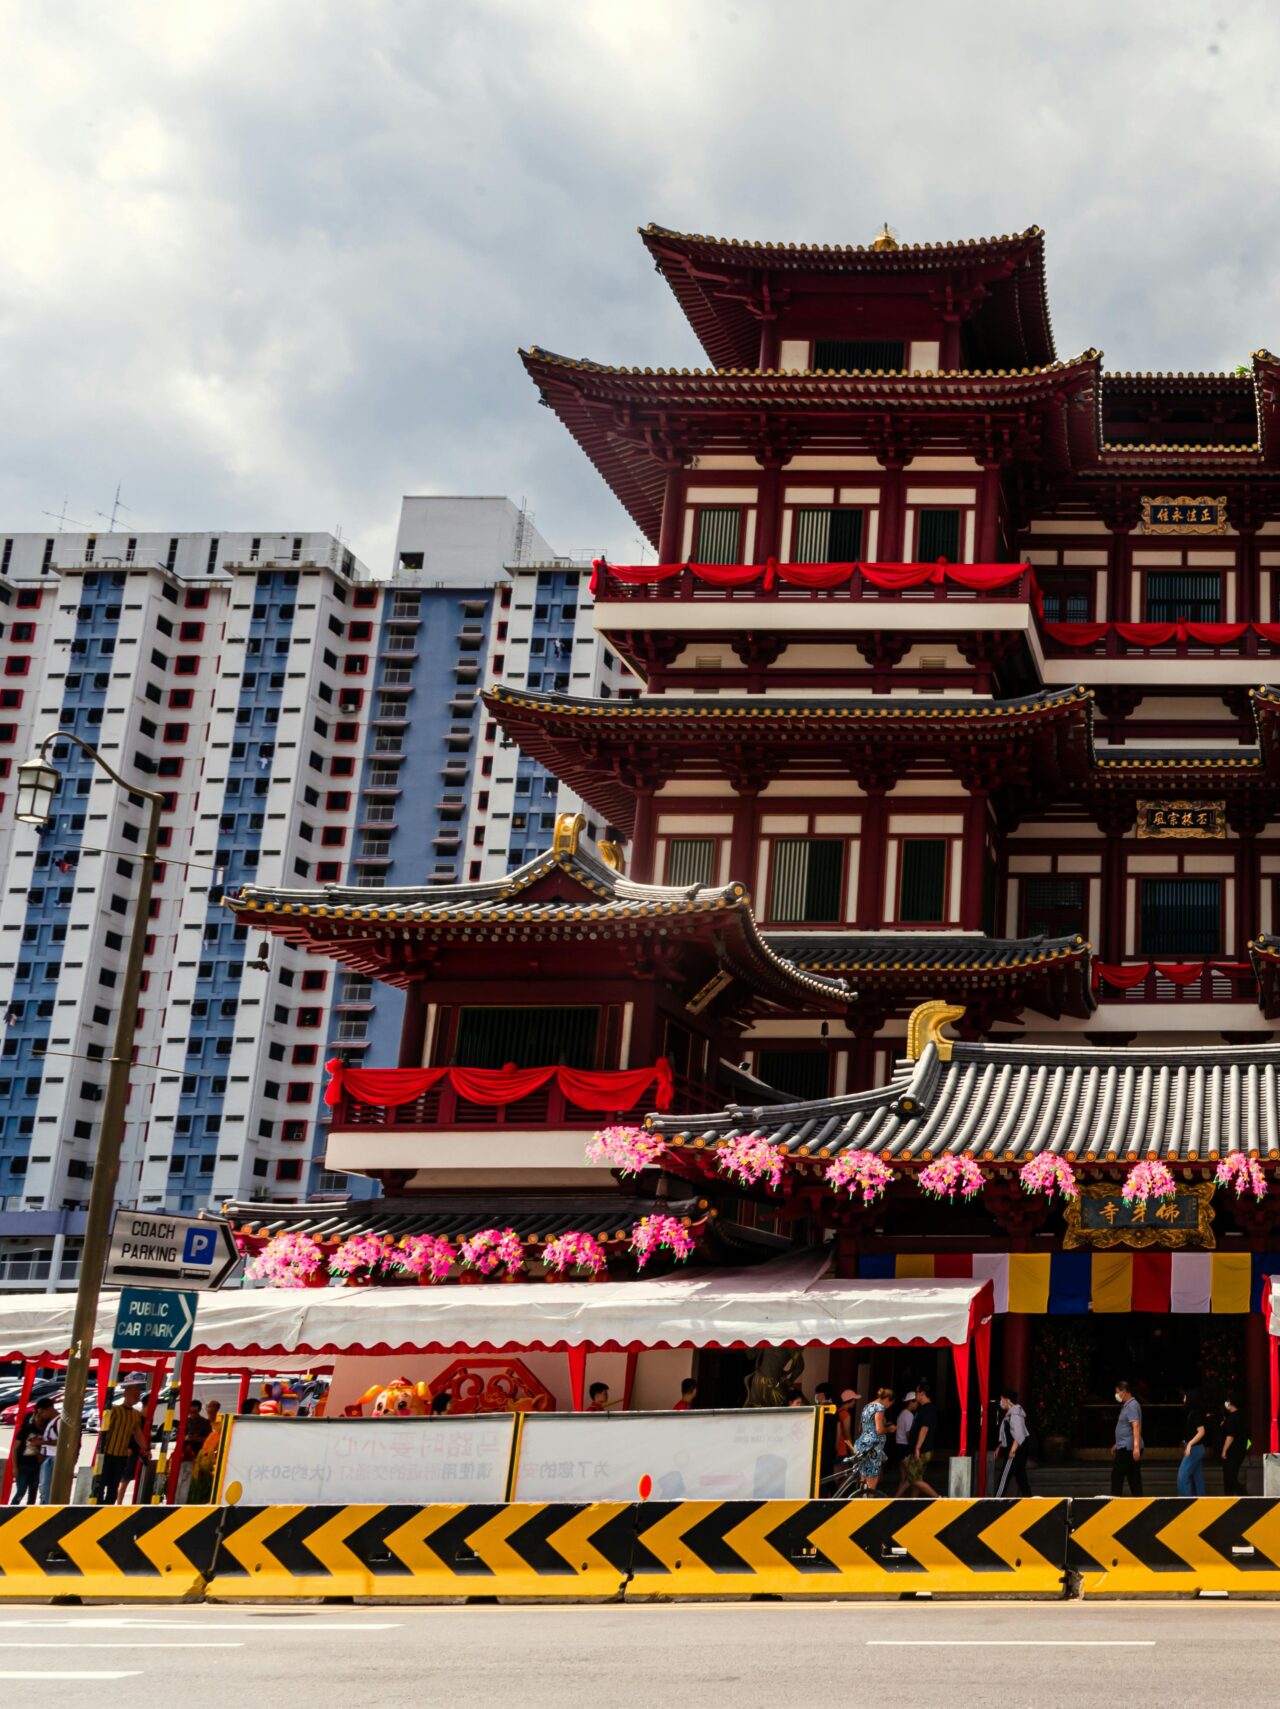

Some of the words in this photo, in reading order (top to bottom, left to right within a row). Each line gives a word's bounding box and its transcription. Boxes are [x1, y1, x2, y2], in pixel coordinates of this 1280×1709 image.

[131, 1220, 176, 1239] COACH
[121, 1243, 177, 1262] PARKING
[190, 1234, 209, 1257] P
[129, 1301, 169, 1317] PUBLIC
[117, 1321, 141, 1336] CAR
[144, 1323, 175, 1338] PARK
